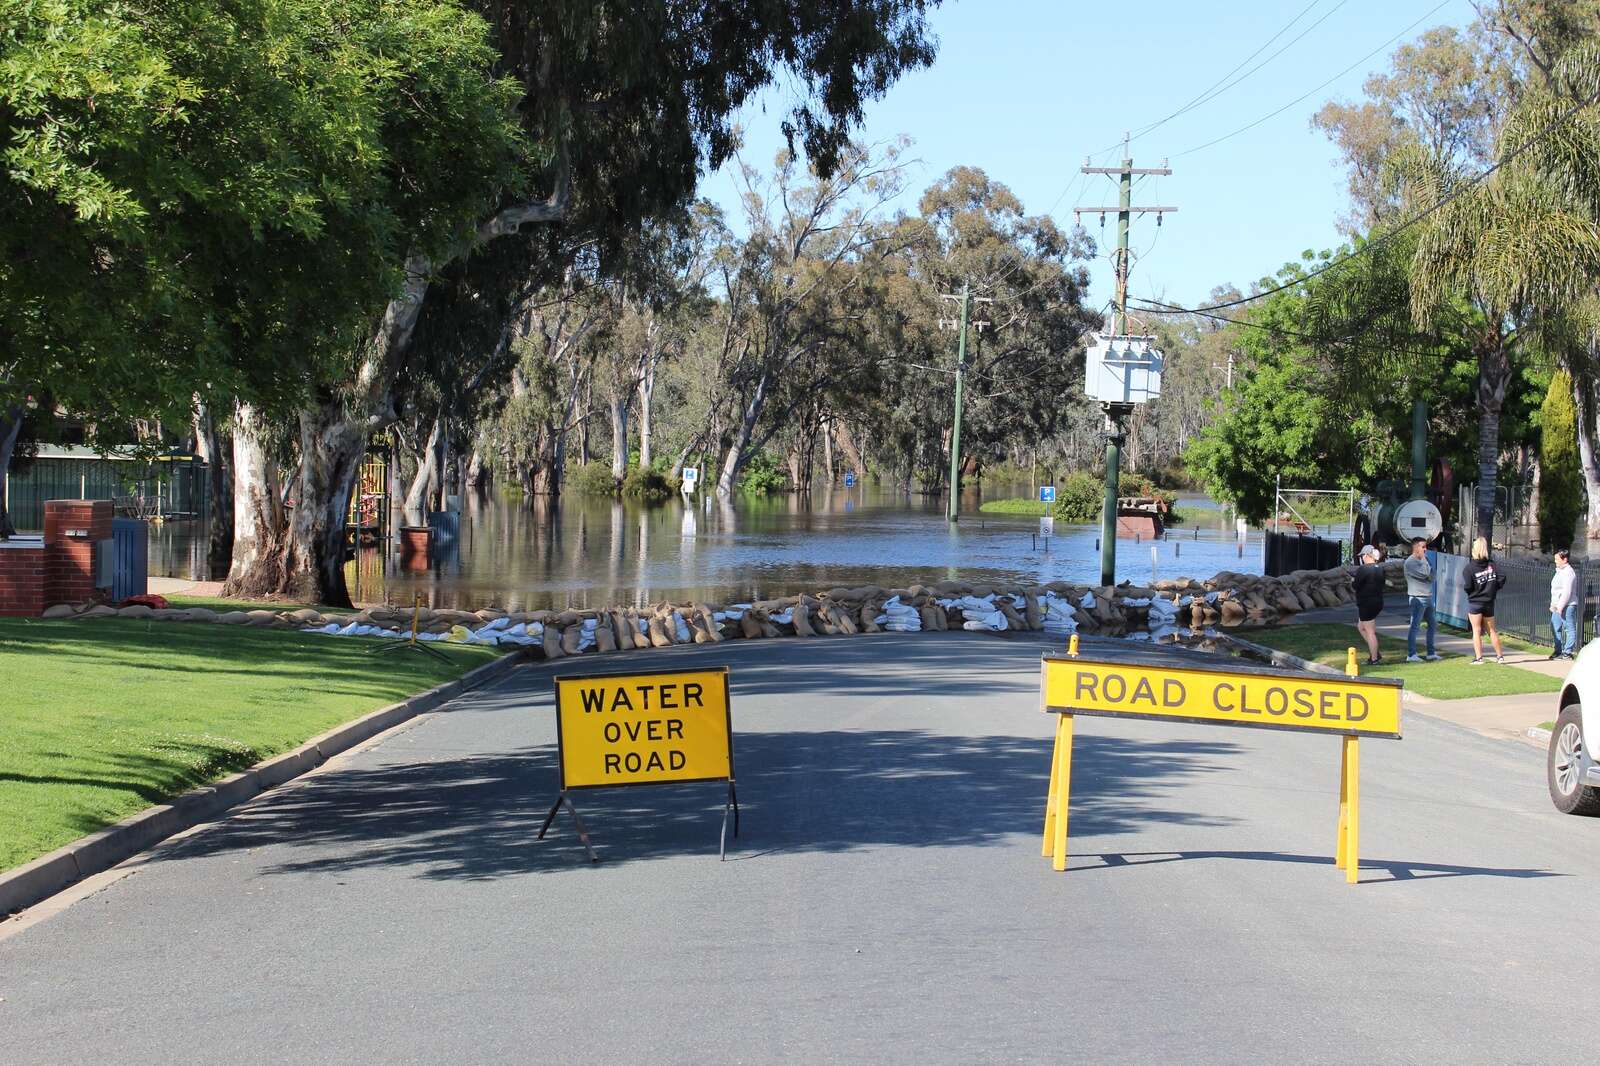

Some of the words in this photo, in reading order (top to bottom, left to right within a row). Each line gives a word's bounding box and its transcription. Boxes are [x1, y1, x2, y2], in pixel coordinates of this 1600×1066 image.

[580, 683, 704, 713] WATER
[1075, 671, 1187, 707] ROAD
[1212, 682, 1369, 722] CLOSED
[604, 719, 684, 743] OVER
[605, 750, 686, 774] ROAD
